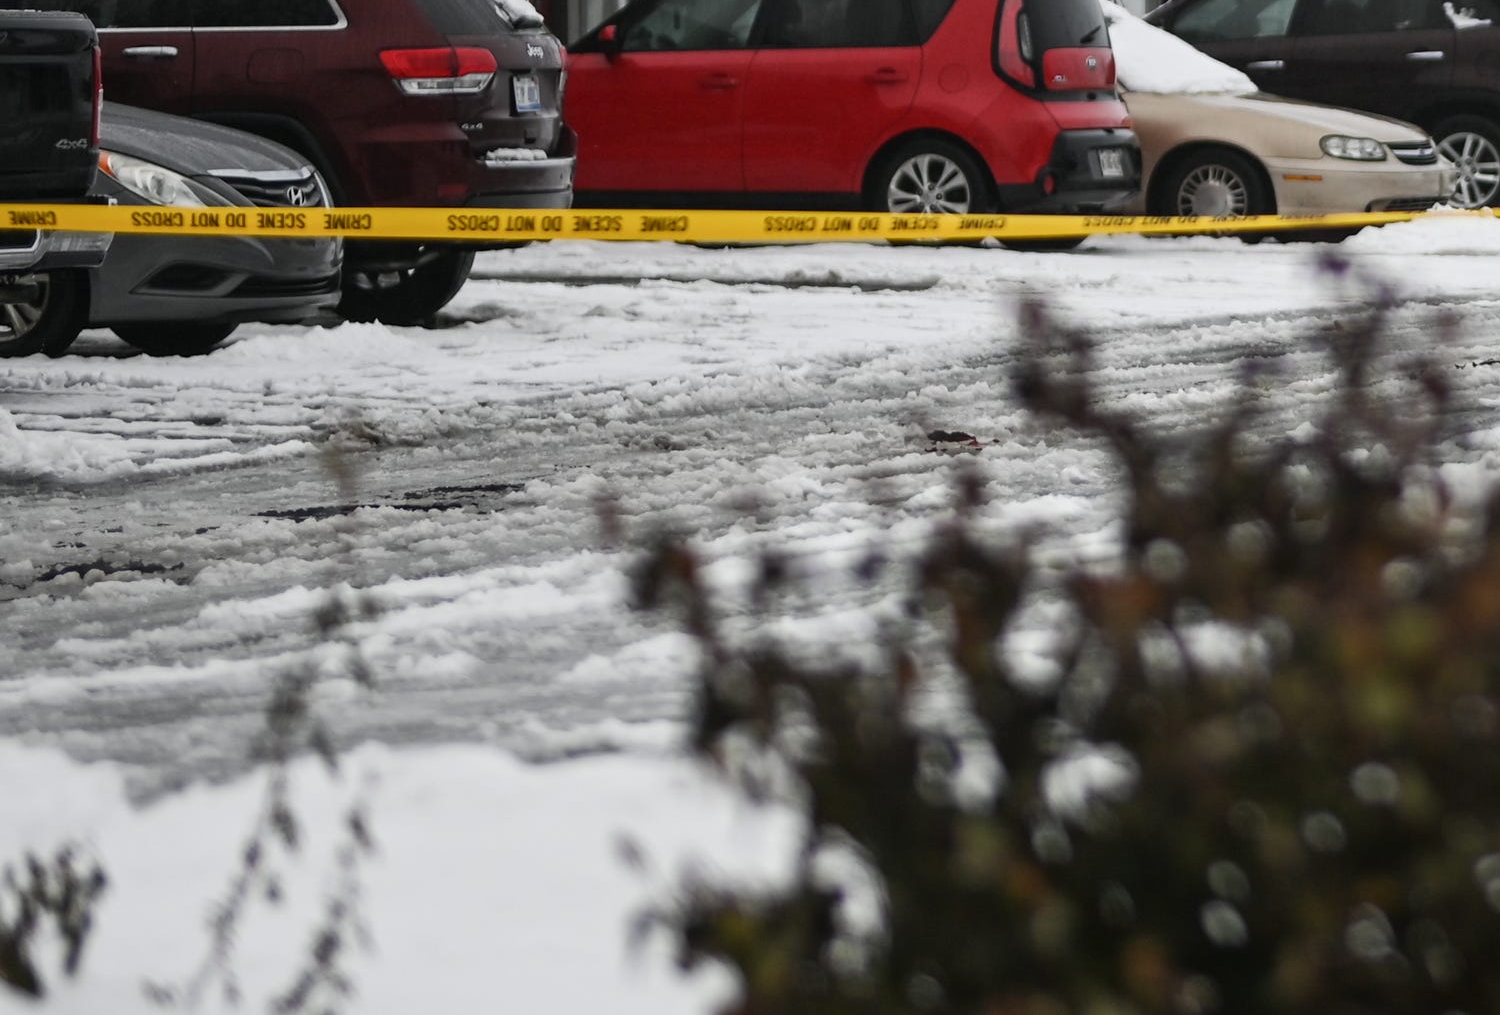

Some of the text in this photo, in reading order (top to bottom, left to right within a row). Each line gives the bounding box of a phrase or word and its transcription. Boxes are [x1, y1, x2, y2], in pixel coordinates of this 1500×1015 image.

[8, 210, 57, 225] CRIME
[131, 211, 372, 229] CRIME SCENE DO NOT CROSS
[447, 214, 689, 232] CRIME SCENE DO NOT CROSS
[764, 216, 817, 232] CROSS
[822, 216, 852, 232] NOT
[856, 216, 880, 232] DO
[889, 215, 939, 231] SCENE
